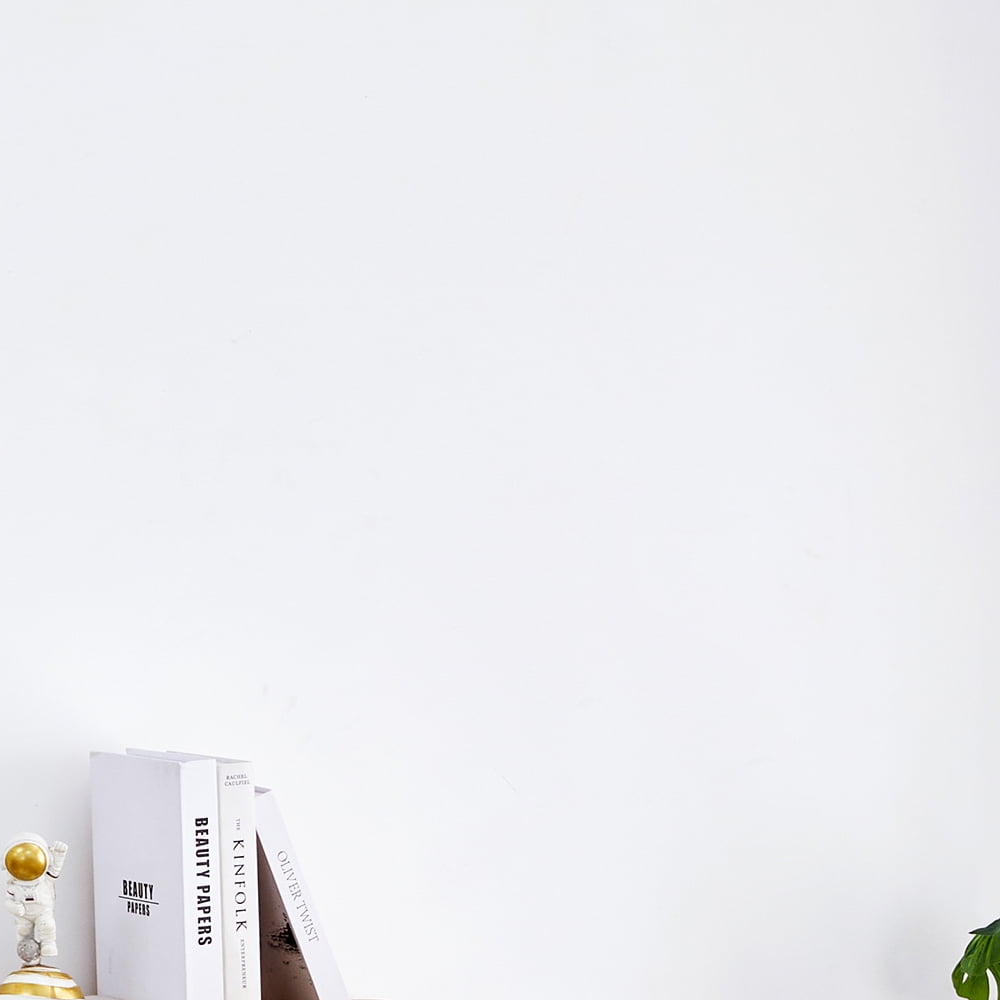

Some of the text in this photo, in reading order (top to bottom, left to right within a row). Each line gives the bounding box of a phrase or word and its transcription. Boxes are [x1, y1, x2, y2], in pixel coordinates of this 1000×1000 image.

[122, 879, 153, 900] BEAUTY
[127, 901, 150, 917] PAPERS
[194, 817, 212, 946] BEAUTY PAPERS
[232, 839, 248, 932] KINFOLK
[276, 850, 320, 942] OLIVER TWIST
